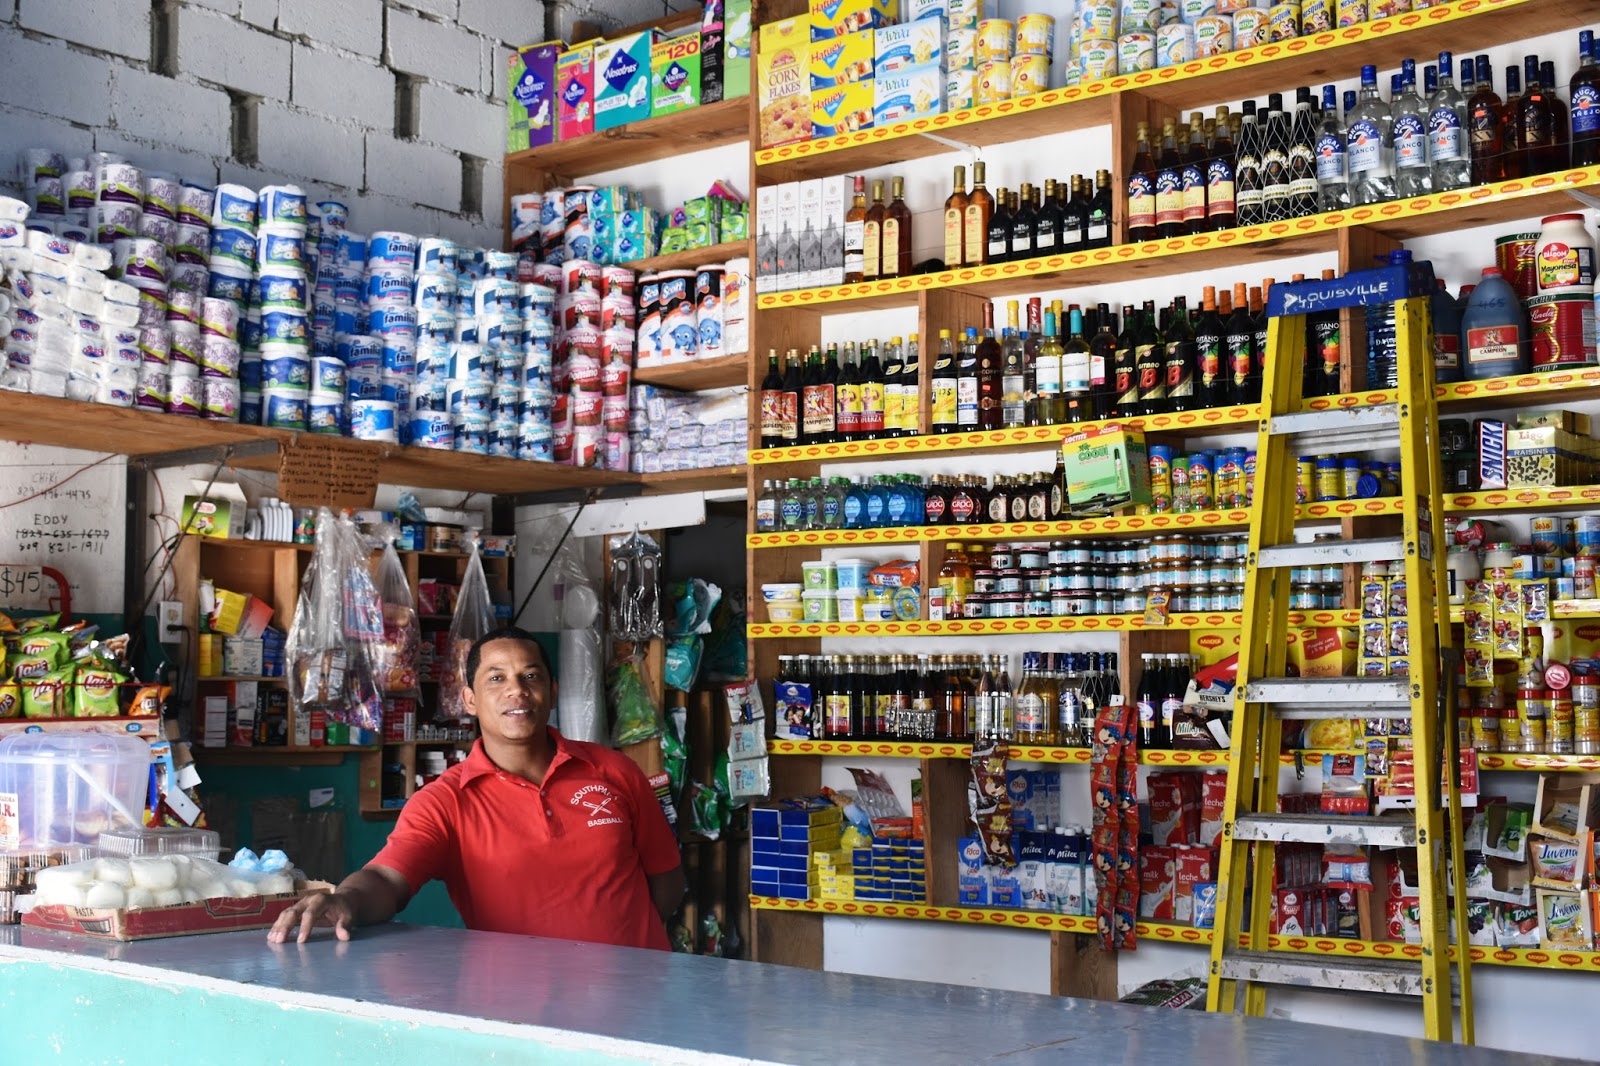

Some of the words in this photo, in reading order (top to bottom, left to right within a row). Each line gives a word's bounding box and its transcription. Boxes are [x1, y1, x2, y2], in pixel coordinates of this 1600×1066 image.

[881, 27, 910, 43] Aviva
[667, 41, 699, 60] 120
[811, 41, 842, 64] Hatuey
[605, 63, 638, 79] Nosotras
[769, 69, 800, 86] CORN
[769, 82, 801, 98] FLAKES
[880, 77, 910, 93] Aviva
[812, 90, 843, 112] Hatuey
[1572, 88, 1598, 104] BRUGAL
[1430, 111, 1457, 127] BRUGAL
[1348, 124, 1374, 140] BRUGAL
[1394, 118, 1421, 134] BRUGAL
[1517, 232, 1542, 240] CATC
[1541, 262, 1578, 274] Mayonesa
[381, 278, 412, 288] familia
[644, 287, 659, 301] Sco
[662, 281, 684, 299] Scott
[1298, 281, 1389, 302] LOUISVILLE
[384, 313, 415, 324] familia
[1530, 306, 1556, 323] Linda
[1315, 321, 1340, 331] GITANO
[1196, 335, 1219, 343] GITANO
[1227, 335, 1250, 343] GITANO
[1064, 433, 1087, 444] LOCTITE
[1518, 430, 1544, 441] Ligo
[1514, 448, 1549, 457] RAISINS
[926, 501, 943, 509] GROG
[952, 500, 972, 509] GROG
[34, 514, 69, 526] EDDY
[0, 567, 41, 598] $45
[1199, 694, 1226, 703] HERSHEY'S
[571, 785, 613, 805] SOUTHPA
[1204, 798, 1225, 808] leche
[587, 817, 623, 827] BASEBALL
[1022, 846, 1043, 855] Milex
[1057, 849, 1078, 859] Milex
[1143, 870, 1159, 880] milk
[1178, 872, 1199, 881] leche
[75, 907, 94, 918] PASTA
